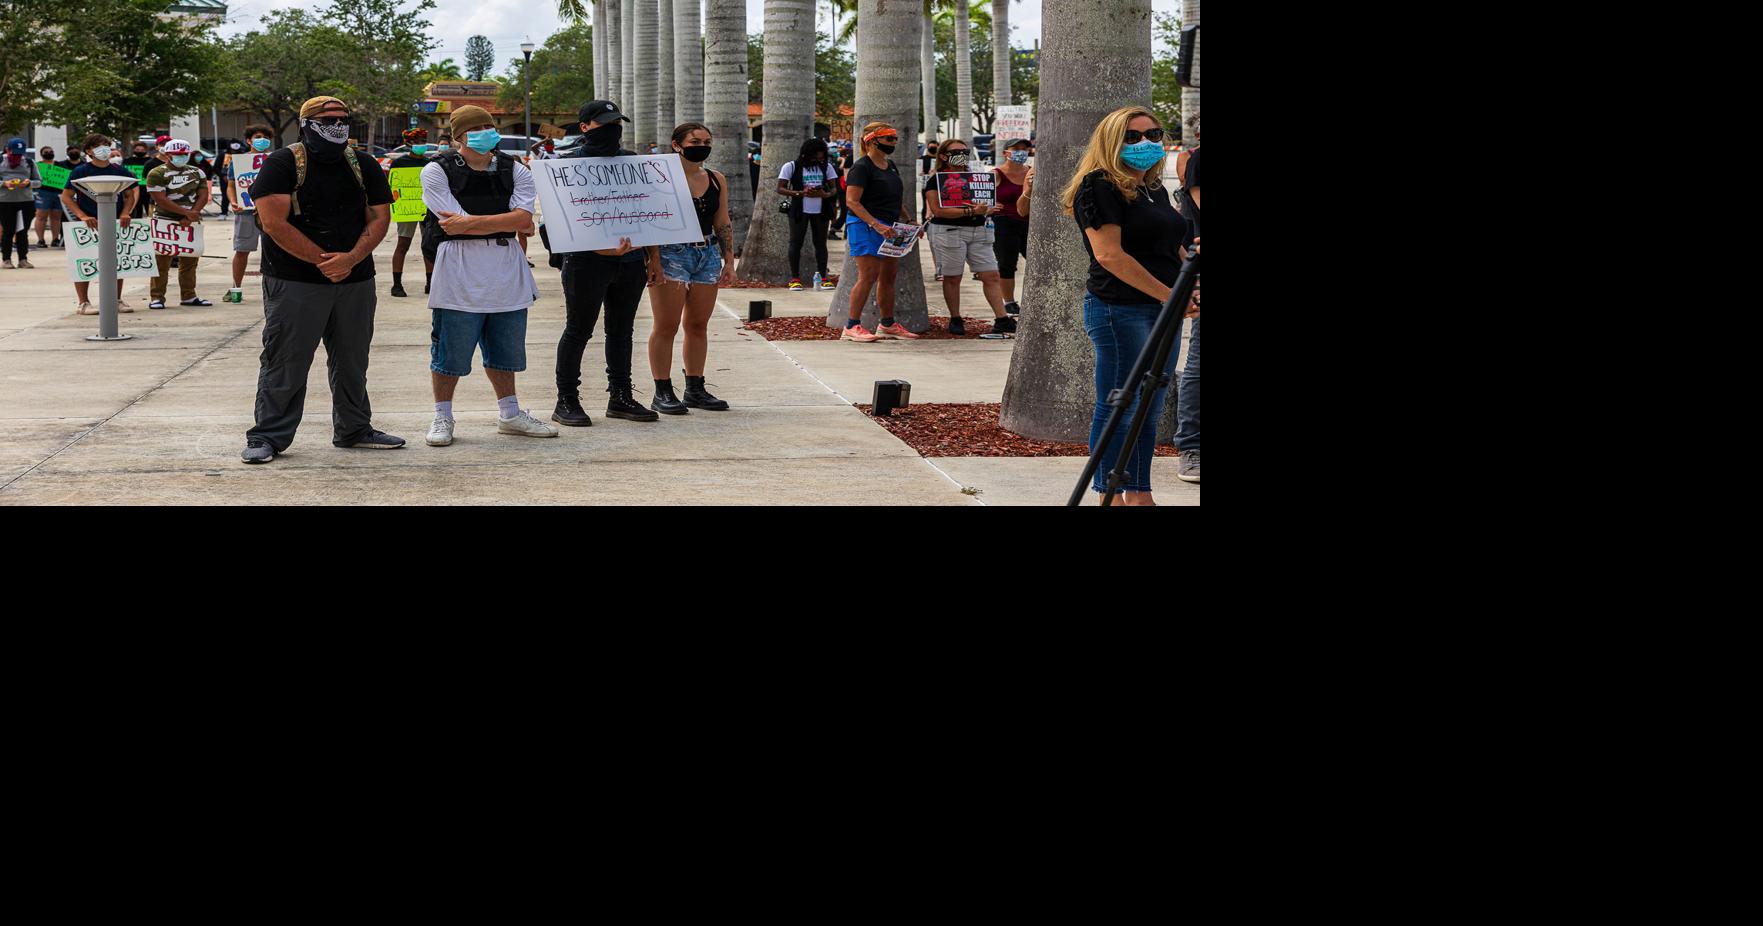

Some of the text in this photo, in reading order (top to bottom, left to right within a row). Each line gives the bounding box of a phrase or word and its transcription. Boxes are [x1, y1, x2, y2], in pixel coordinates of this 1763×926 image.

[551, 161, 669, 187] HE'S SOMEONE'S
[972, 174, 991, 182] STOP
[172, 175, 189, 184] NIKE
[969, 182, 994, 190] KILLING
[974, 190, 991, 198] EACH
